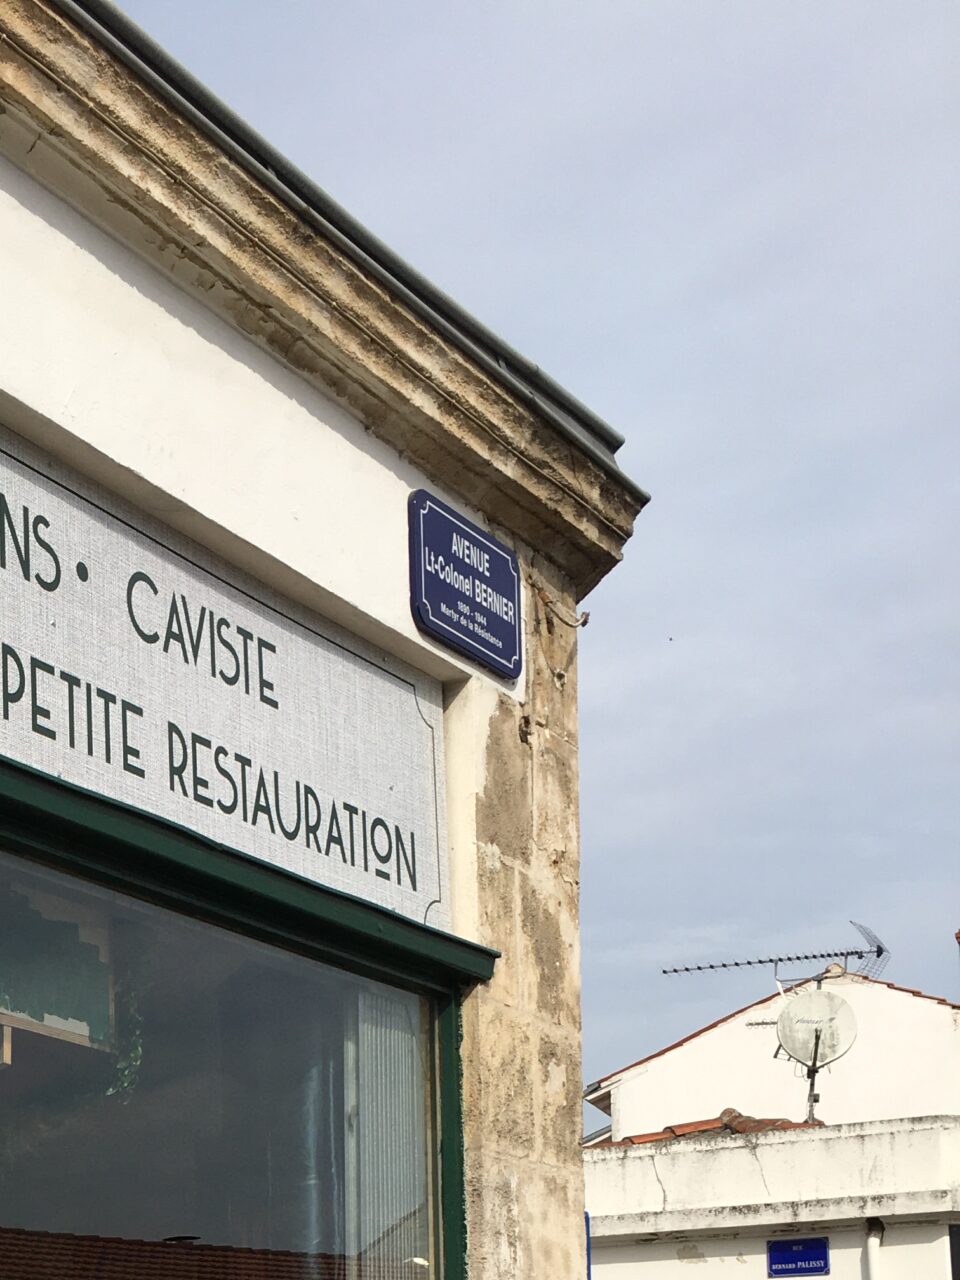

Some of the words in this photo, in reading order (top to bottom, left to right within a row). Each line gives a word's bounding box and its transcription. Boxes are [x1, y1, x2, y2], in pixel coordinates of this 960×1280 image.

[425, 546, 473, 598] Lt-Colonel
[475, 580, 515, 625] BERNIER
[451, 532, 490, 577] AVENUE
[126, 571, 279, 710] CAVISTE
[440, 602, 459, 622] Martyr
[460, 615, 467, 627] de
[468, 620, 473, 631] la
[474, 623, 502, 648] Résistance
[1, 642, 146, 779] PETITE
[167, 721, 418, 892] RESTAURATION
[797, 1260, 824, 1268] PALISSY
